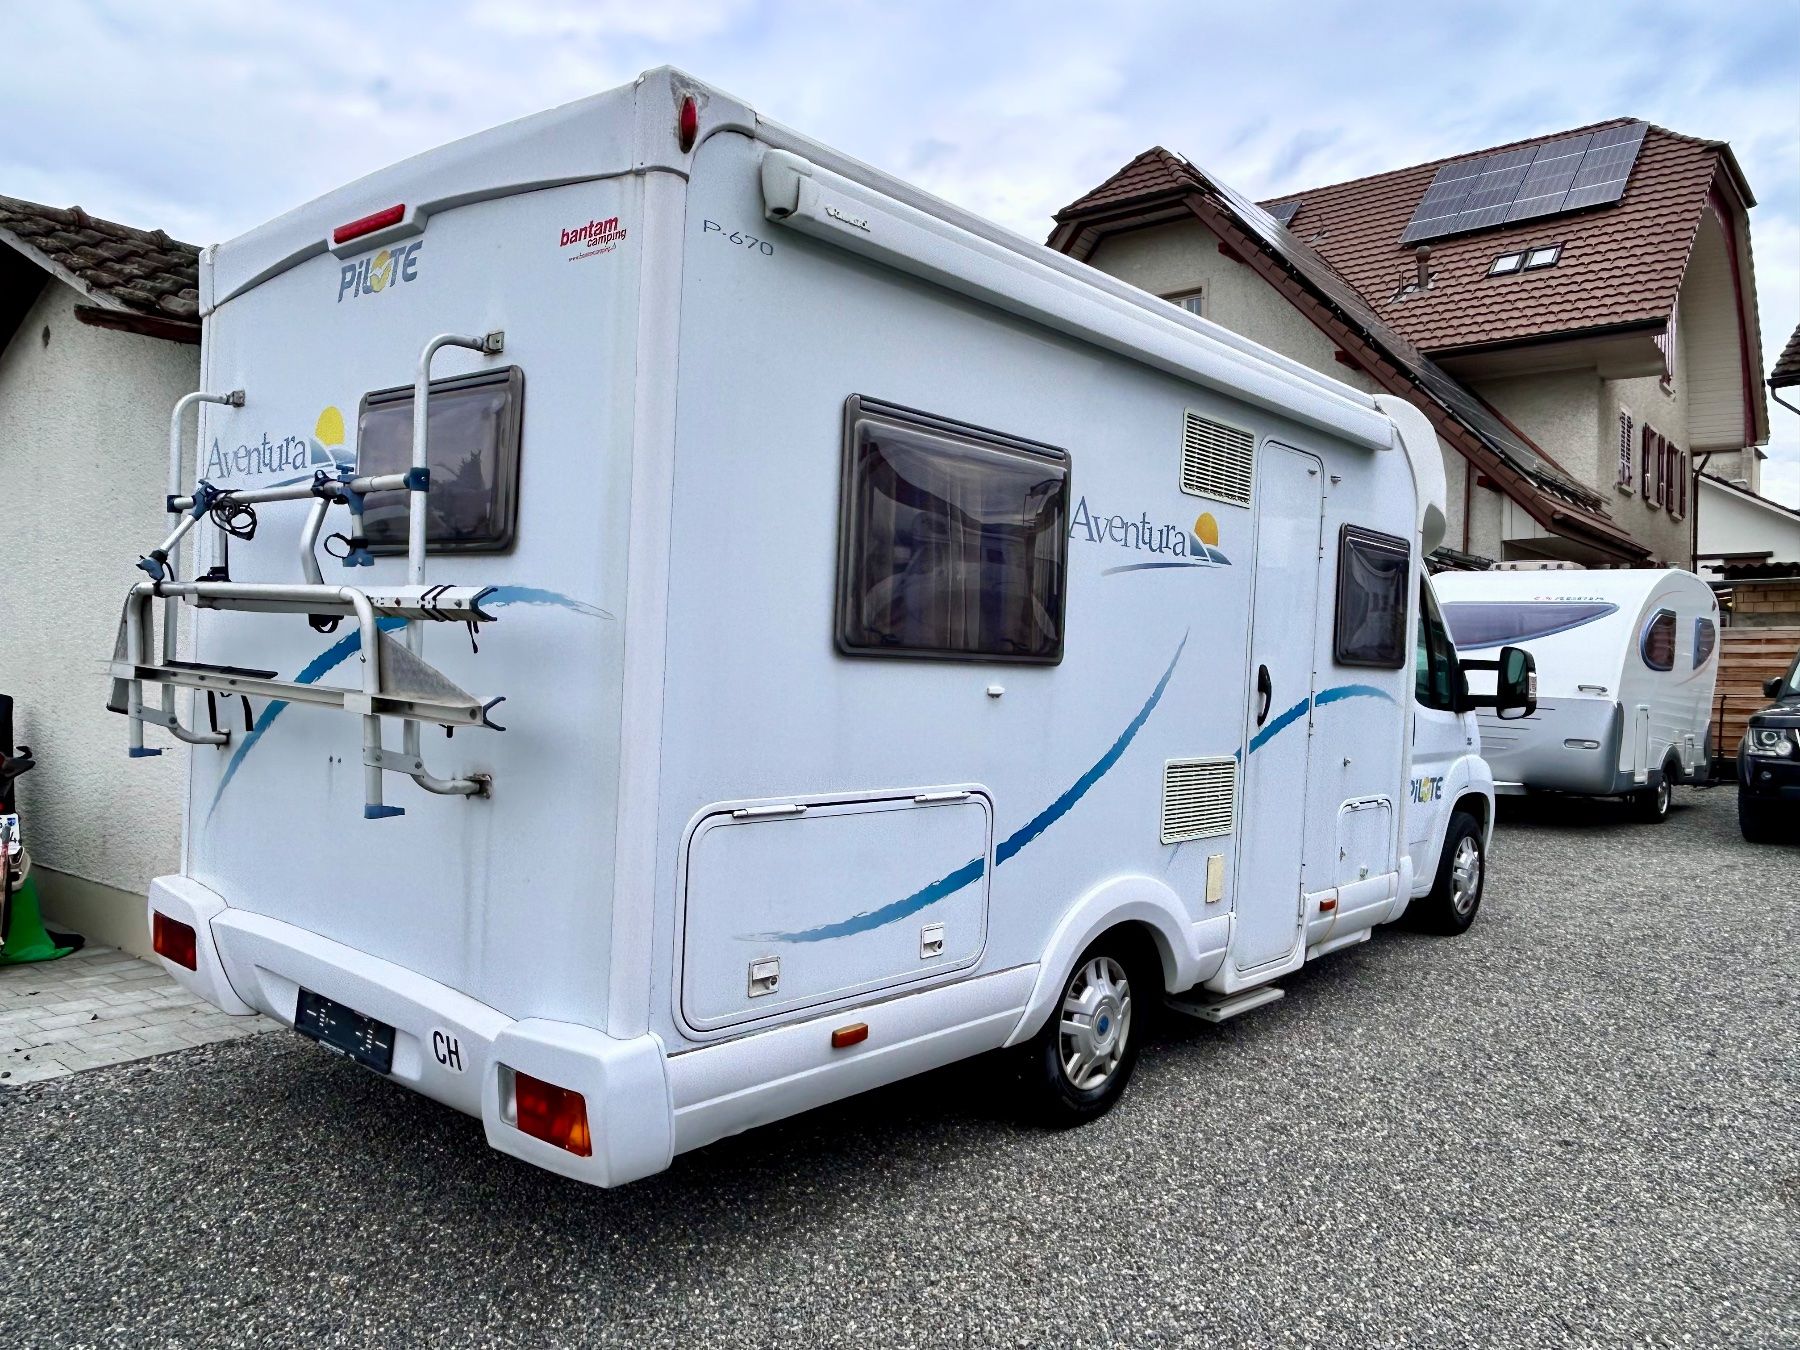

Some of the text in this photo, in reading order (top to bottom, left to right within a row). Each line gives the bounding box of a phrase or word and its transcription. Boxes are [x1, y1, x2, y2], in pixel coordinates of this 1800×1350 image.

[560, 216, 619, 247] bantam
[587, 228, 627, 248] camping
[703, 219, 774, 255] P-670
[205, 431, 308, 479] Aventura
[1069, 495, 1187, 558] Aventura
[432, 1030, 463, 1072] CH
